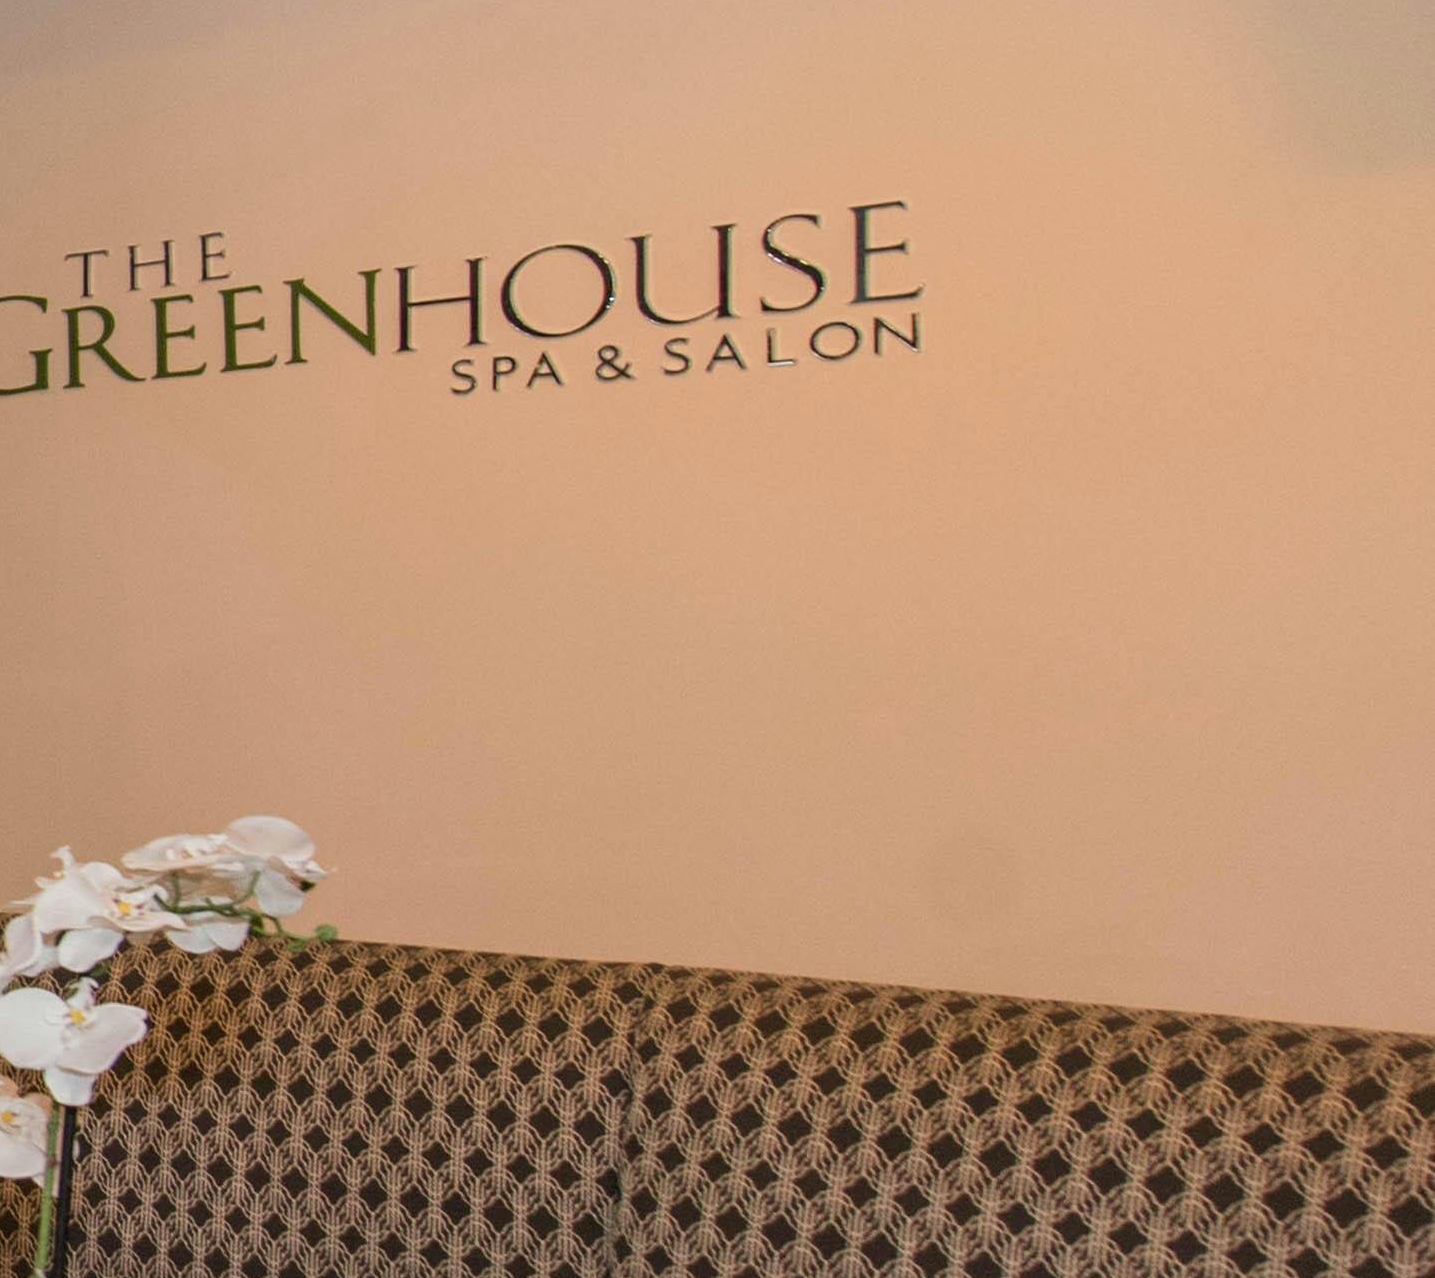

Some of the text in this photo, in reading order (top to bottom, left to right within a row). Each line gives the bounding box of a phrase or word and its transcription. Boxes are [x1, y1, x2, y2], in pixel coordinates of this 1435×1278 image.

[64, 231, 231, 299] THE
[451, 311, 922, 397] SPA & SALON
